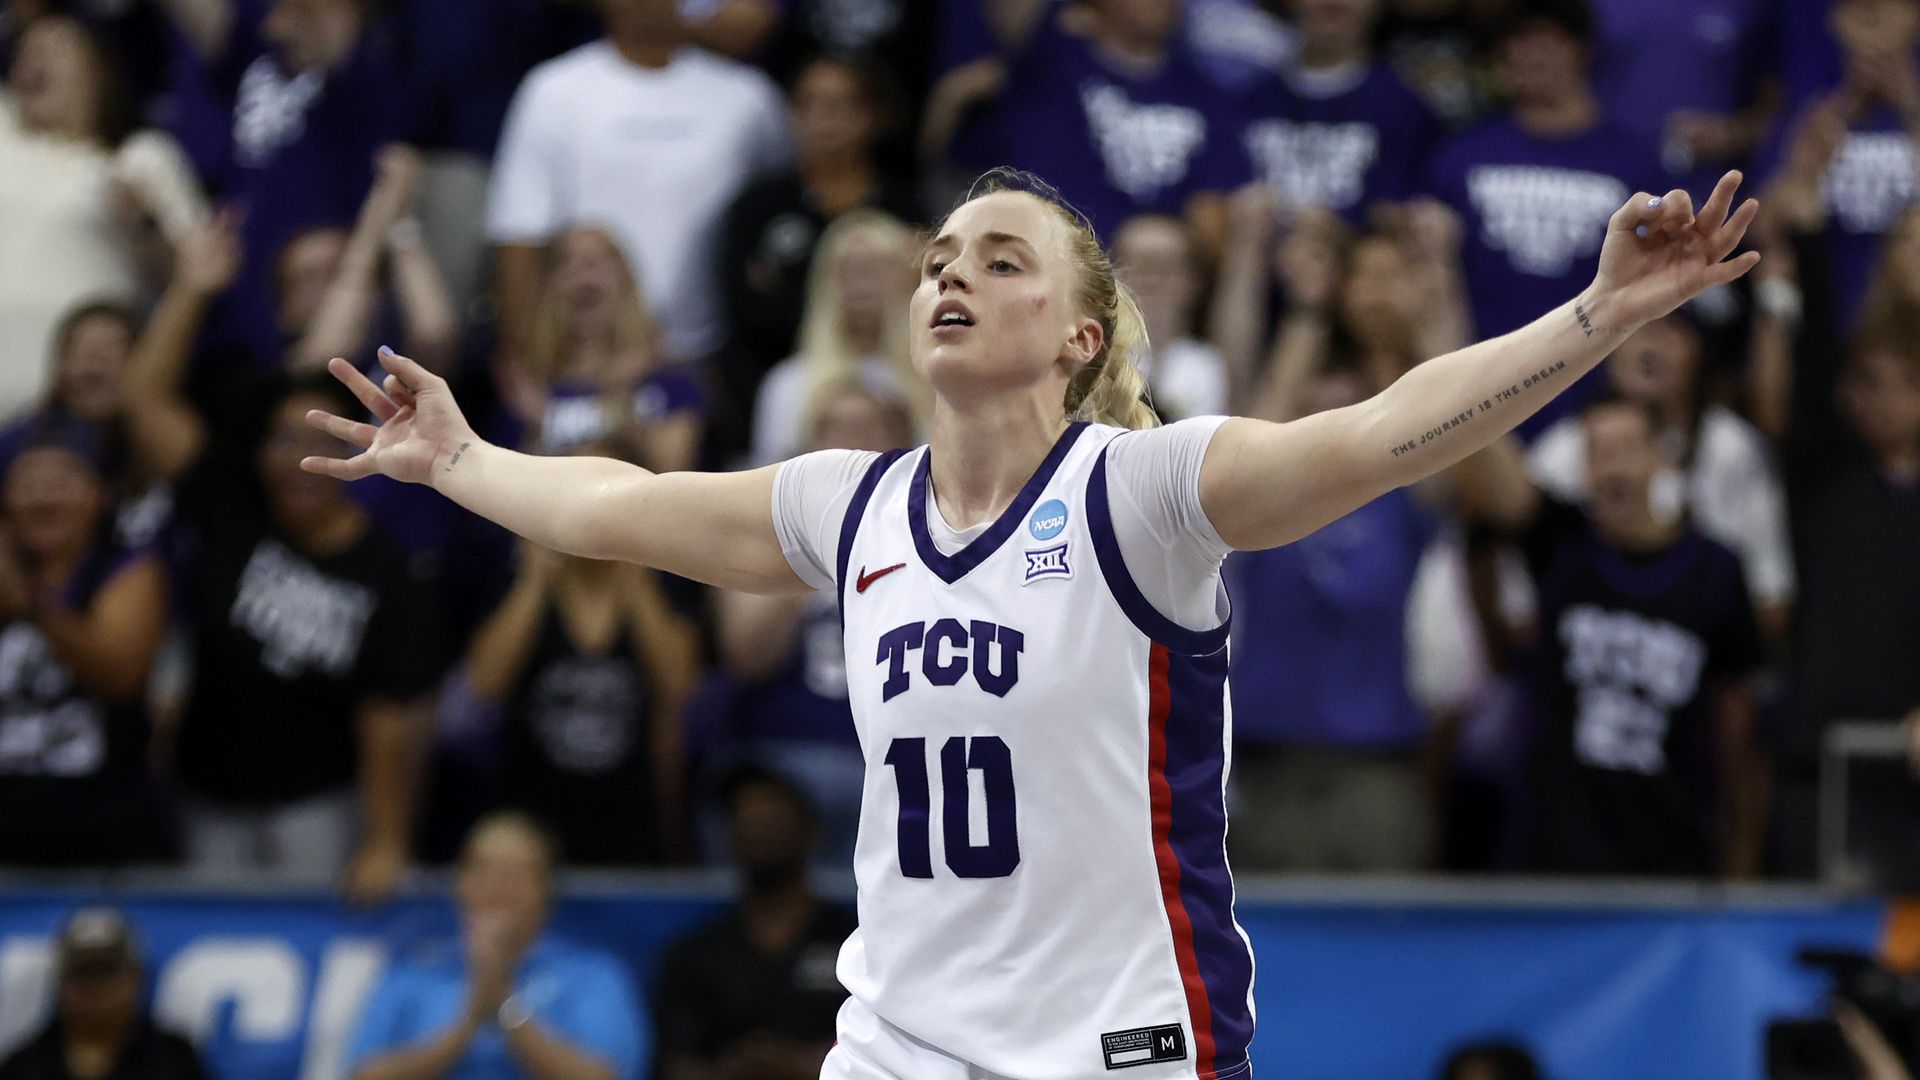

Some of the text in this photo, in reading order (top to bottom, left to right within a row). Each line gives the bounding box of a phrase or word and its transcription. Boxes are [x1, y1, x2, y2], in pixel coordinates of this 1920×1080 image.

[1391, 360, 1566, 458] THE JOURNEY IS THE DREAM
[1034, 515, 1065, 532] NCAA
[1027, 546, 1066, 577] XII
[876, 618, 1024, 703] TCU
[884, 735, 1021, 879] 10
[1106, 1033, 1150, 1044] ENGINEERED
[1160, 1035, 1175, 1051] M
